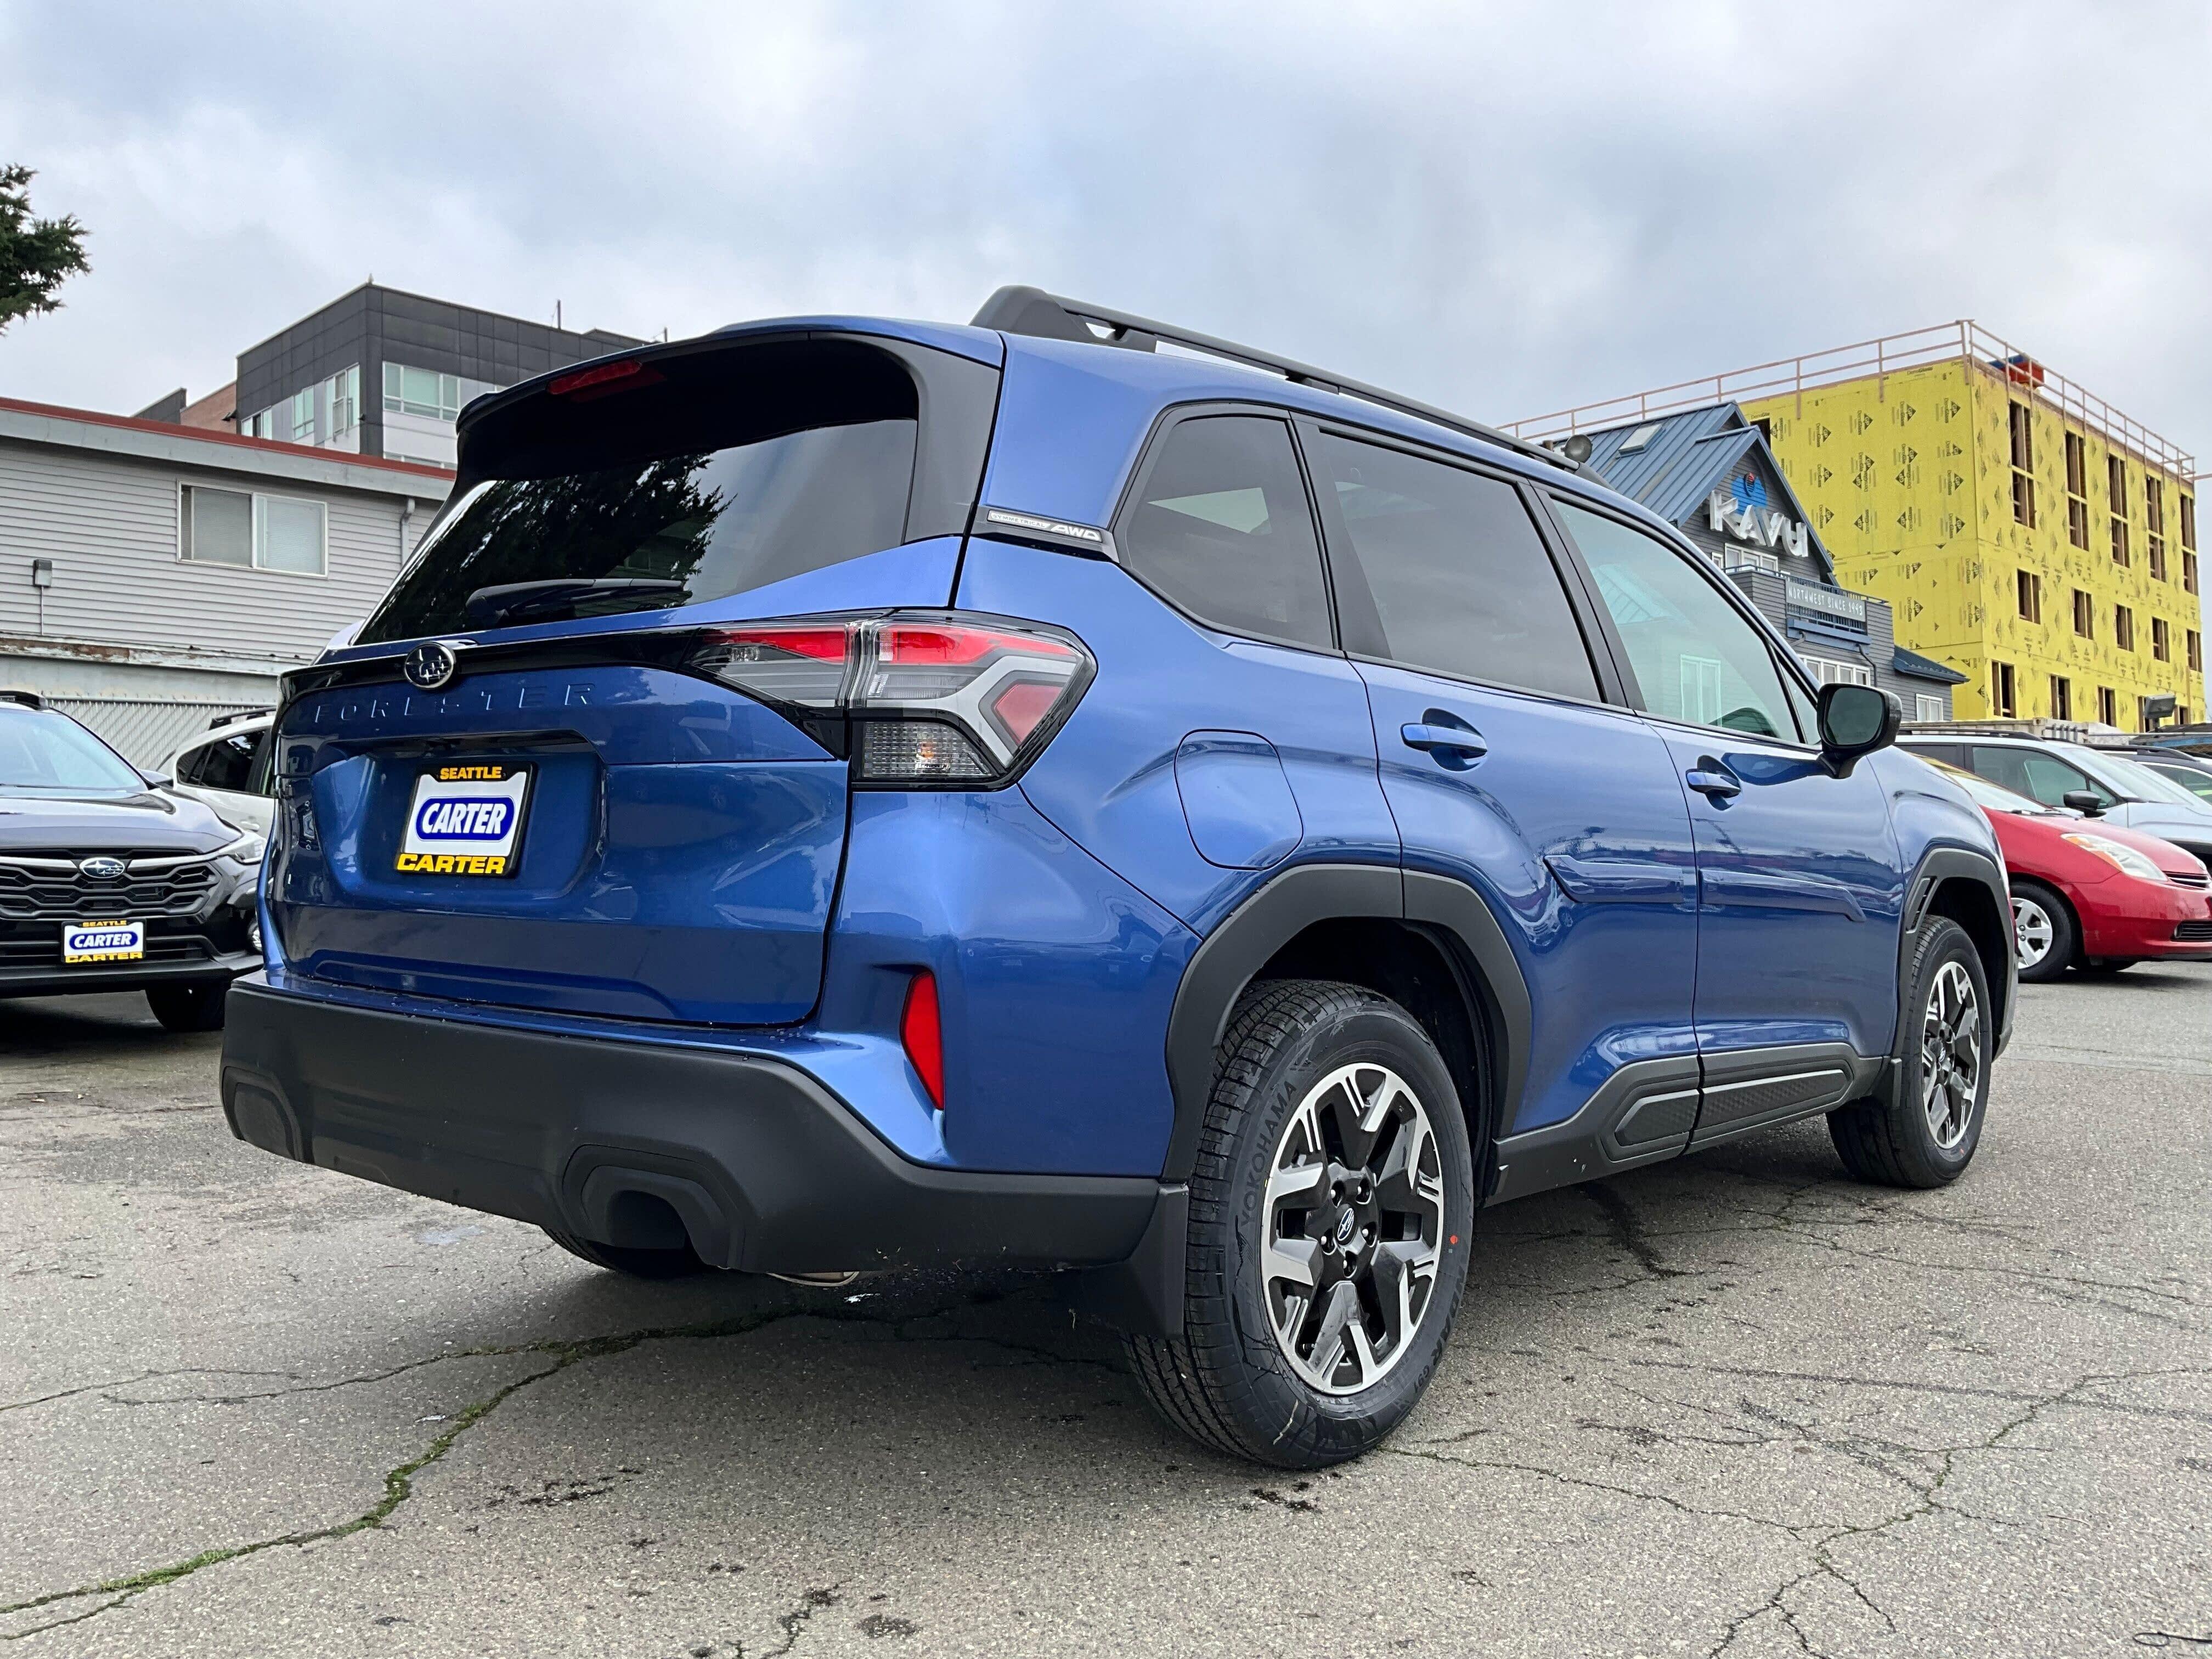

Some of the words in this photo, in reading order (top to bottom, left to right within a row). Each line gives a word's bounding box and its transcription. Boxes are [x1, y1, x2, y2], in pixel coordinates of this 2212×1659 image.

[992, 514, 1046, 528] SYMMETRICAL
[1050, 524, 1102, 543] AWD
[1709, 490, 1808, 557] KAVU
[1788, 586, 1824, 606] NORTHWEST
[1827, 596, 1846, 611] SINCE
[1848, 602, 1863, 616] 1993
[440, 766, 502, 780] SEATTLE
[422, 803, 507, 834] CARTER
[397, 854, 506, 874] CARTER
[74, 933, 132, 948] CARTER
[65, 952, 143, 963] CARTER
[1240, 1080, 1297, 1227] YOKOHAMA
